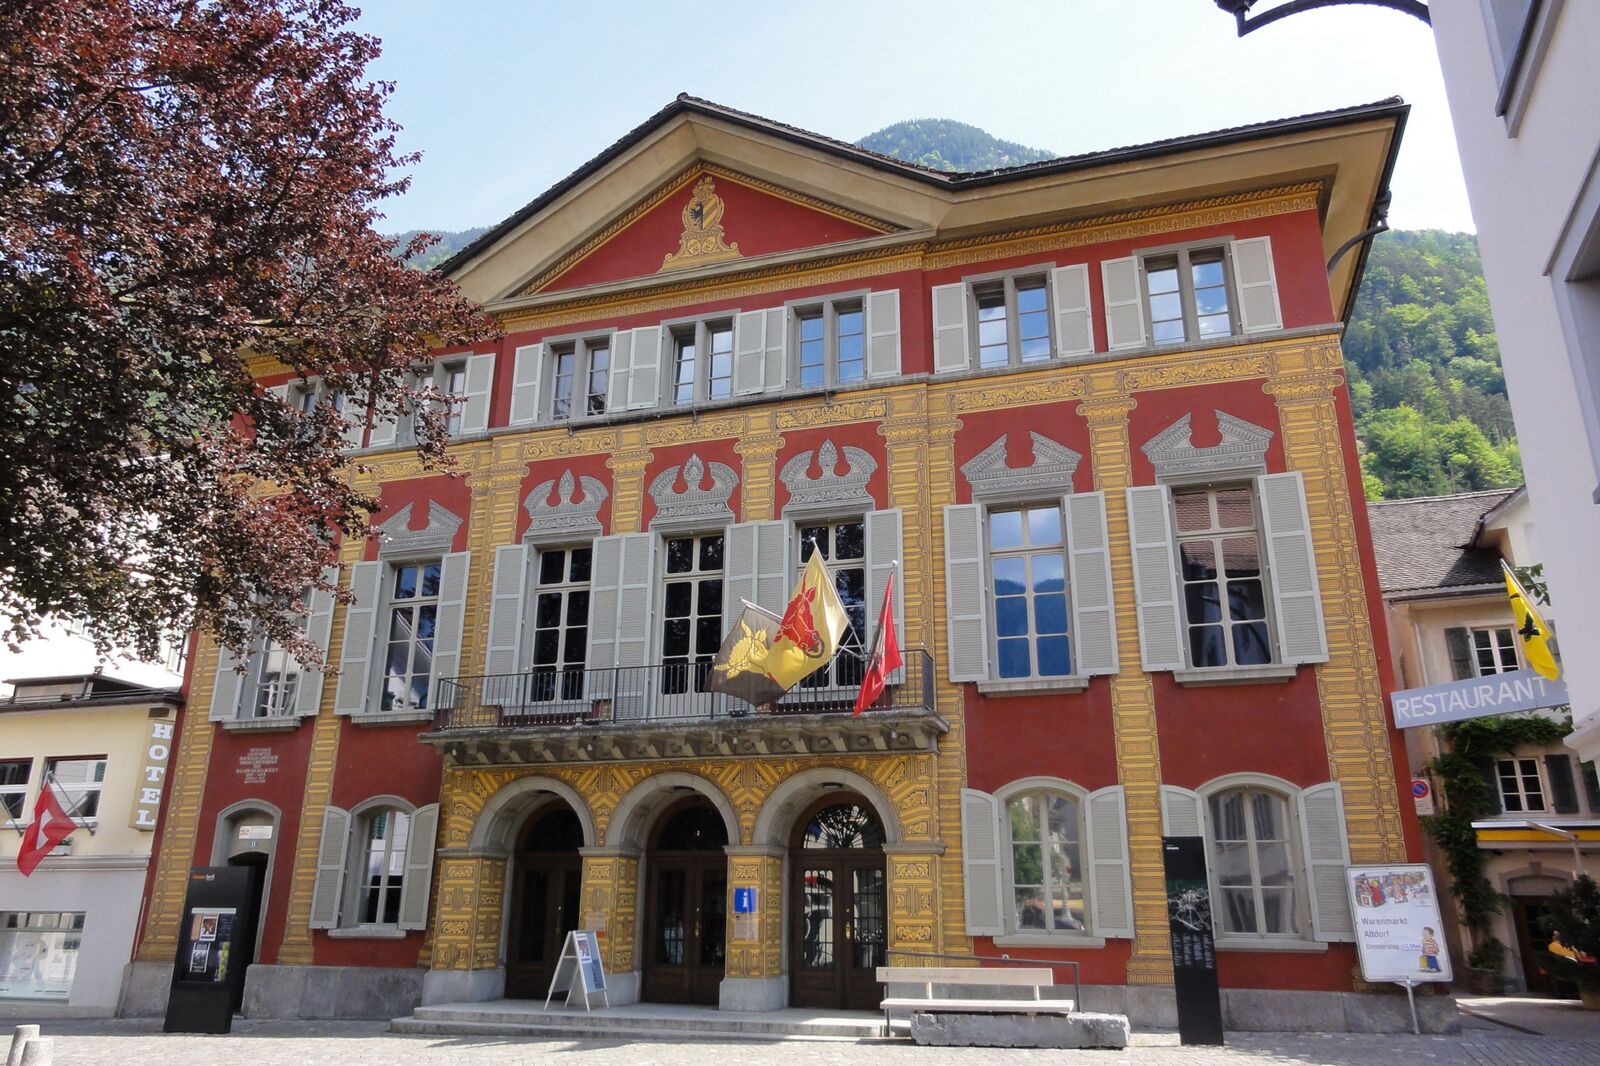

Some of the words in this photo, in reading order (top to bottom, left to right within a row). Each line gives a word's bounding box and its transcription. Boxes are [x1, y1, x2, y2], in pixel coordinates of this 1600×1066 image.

[1395, 676, 1547, 720] RESTAURANT
[136, 723, 173, 825] HOTEL
[1361, 917, 1408, 926] Warenmarkt
[1364, 929, 1389, 938] Altdorf
